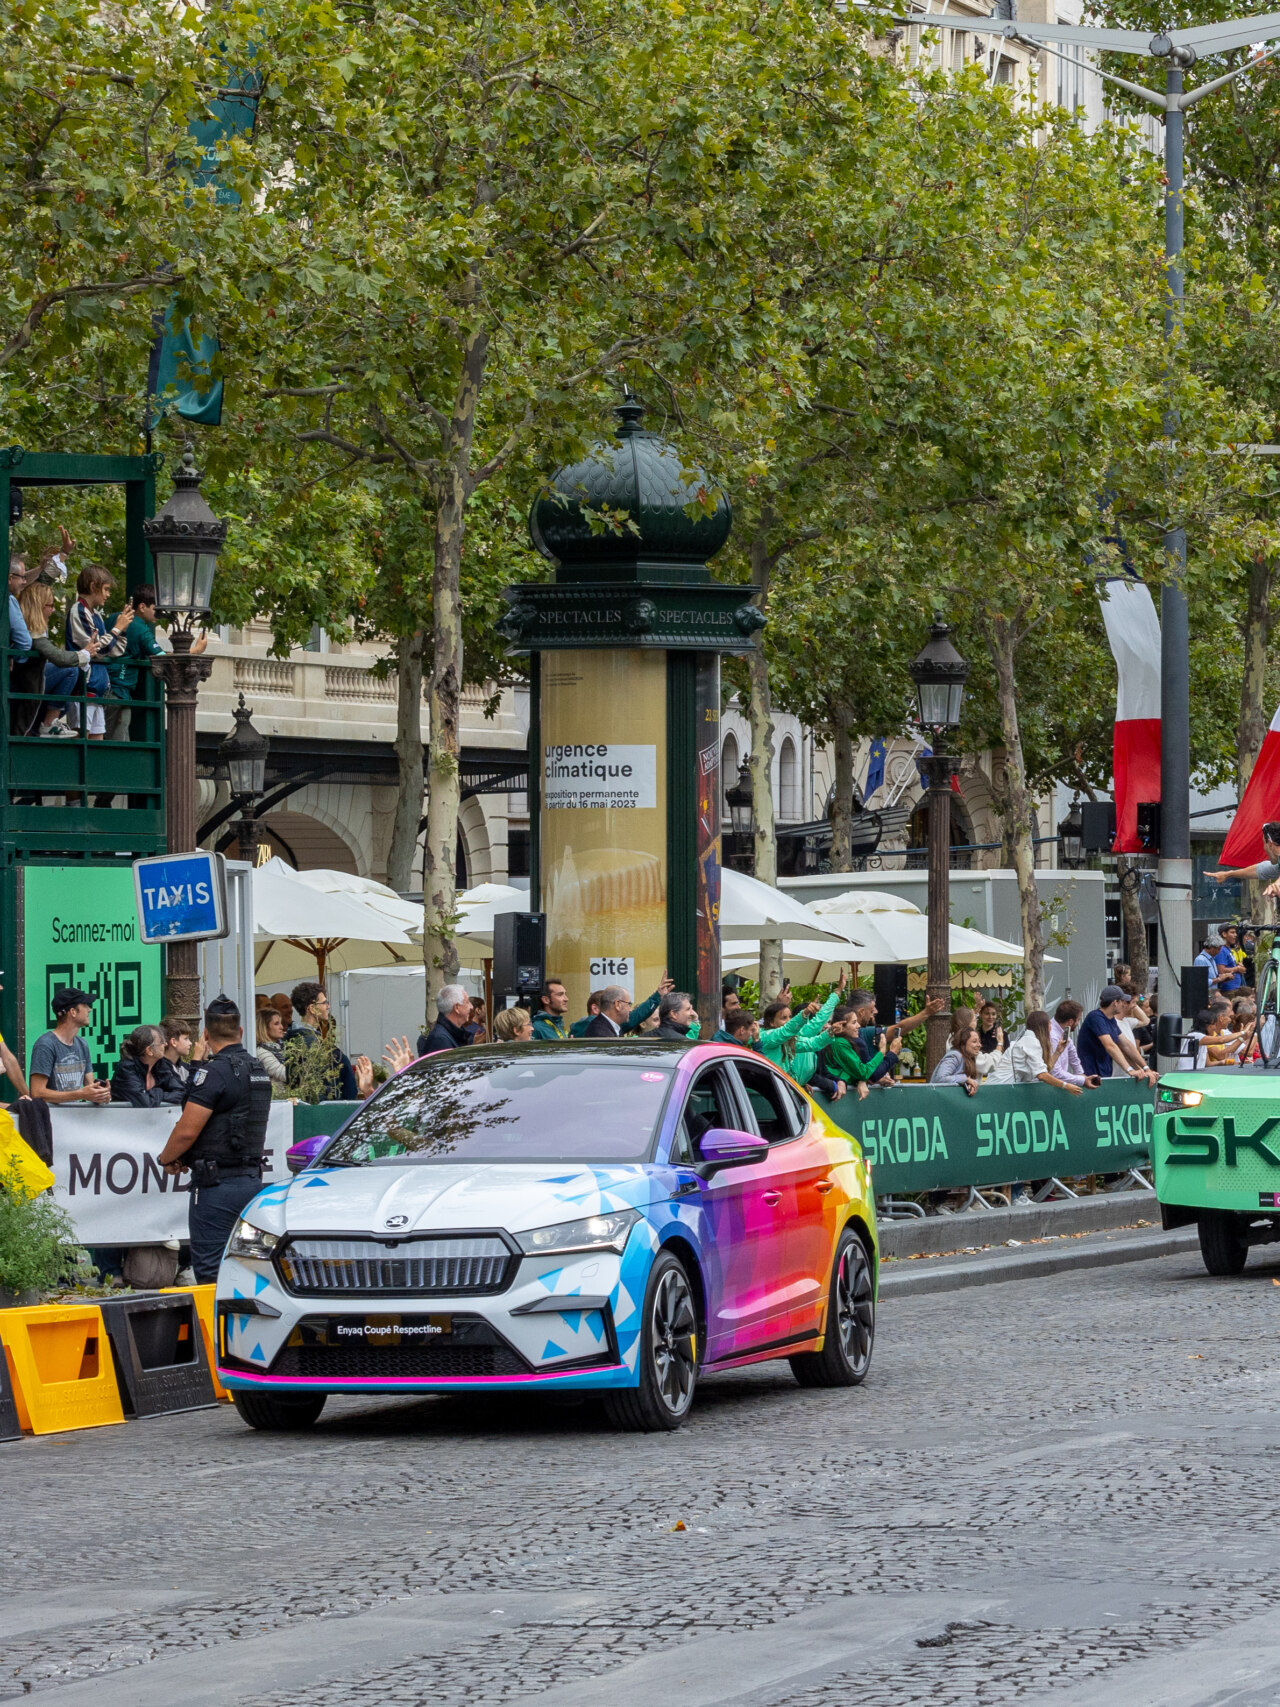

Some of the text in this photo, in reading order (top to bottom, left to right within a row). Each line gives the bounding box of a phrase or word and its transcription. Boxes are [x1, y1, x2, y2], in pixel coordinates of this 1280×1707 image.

[539, 610, 622, 624] SPECTACLES
[658, 610, 733, 625] SPECTACLES
[545, 744, 608, 761] urgence
[545, 760, 633, 781] climatique
[545, 789, 640, 801] exposition permanente
[566, 799, 577, 809] du
[579, 799, 589, 809] 16
[590, 799, 608, 809] mai
[610, 799, 637, 809] 2023
[143, 882, 210, 910] TAXIS
[52, 917, 135, 943] Scannez-moi
[589, 957, 628, 976] cité
[337, 1325, 442, 1336] Enyaq Coupé Respectline
